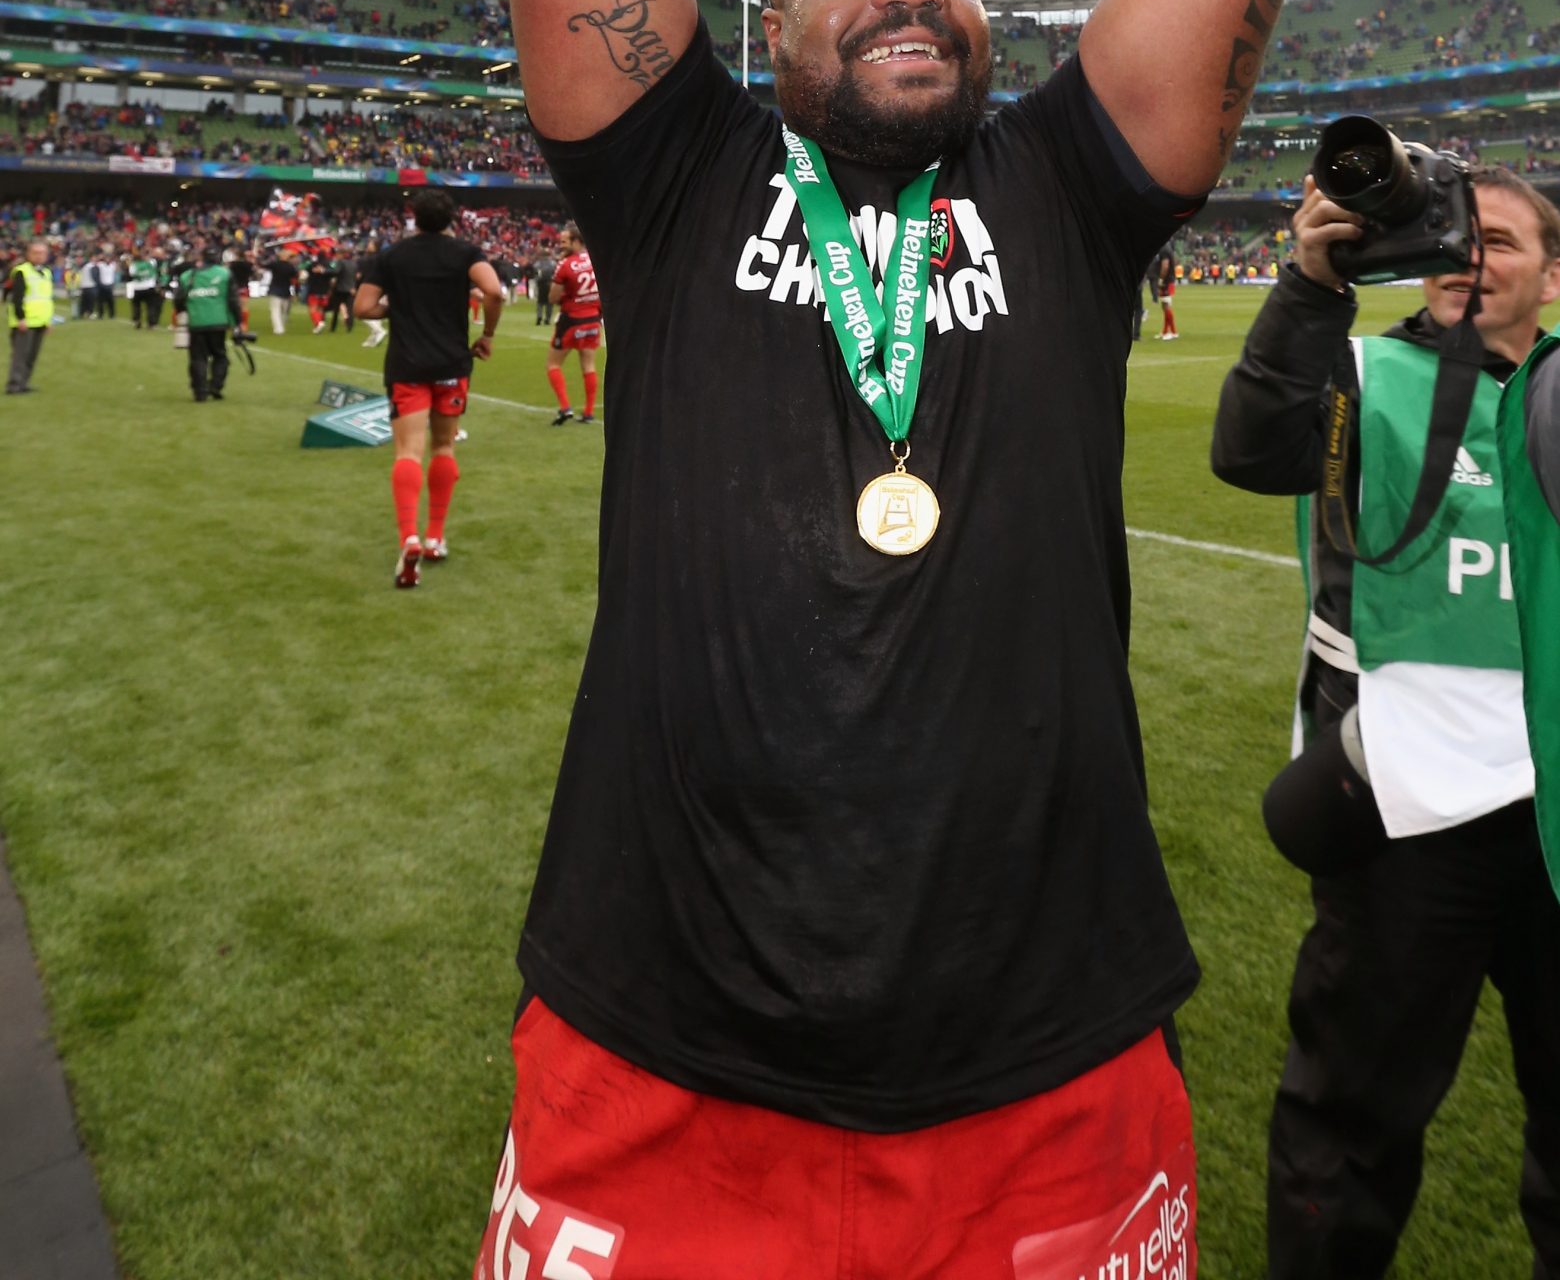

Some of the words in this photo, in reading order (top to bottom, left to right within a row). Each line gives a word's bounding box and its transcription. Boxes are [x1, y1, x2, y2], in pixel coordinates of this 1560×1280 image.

[735, 234, 1010, 336] CHION
[825, 241, 856, 287] Cup
[893, 218, 930, 337] Heineken
[883, 340, 916, 396] Cup
[1328, 391, 1347, 455] Nikon
